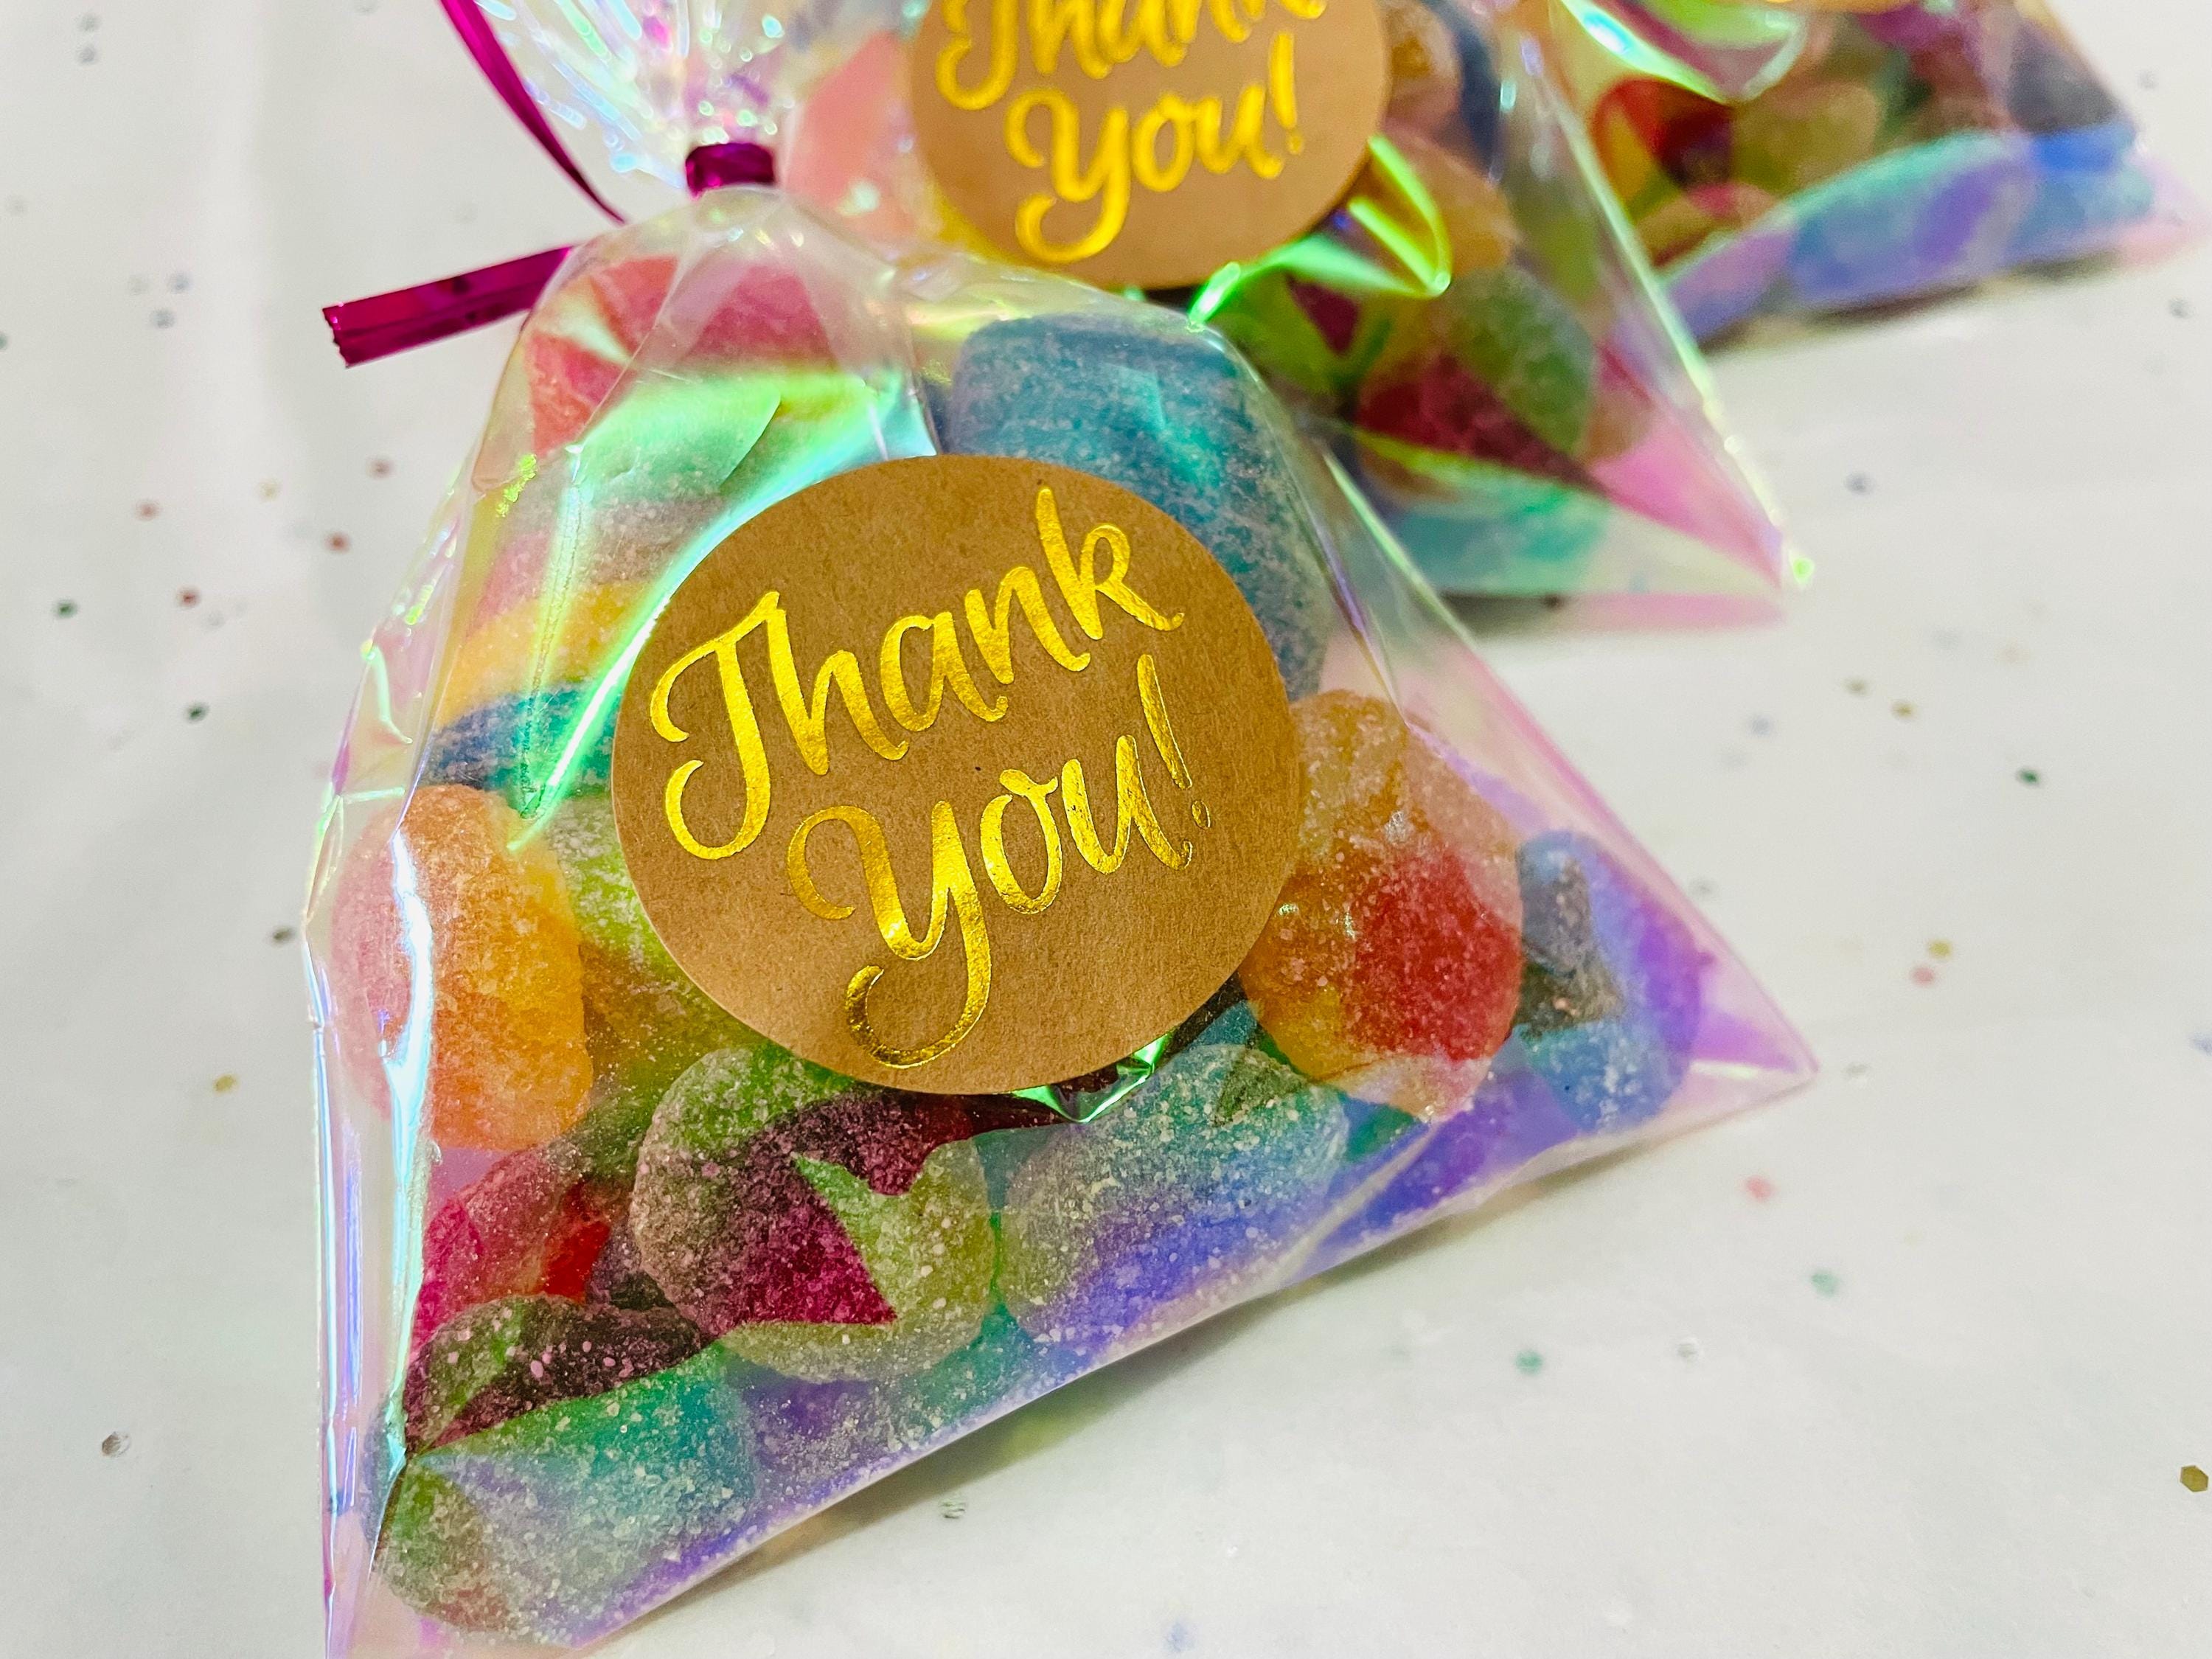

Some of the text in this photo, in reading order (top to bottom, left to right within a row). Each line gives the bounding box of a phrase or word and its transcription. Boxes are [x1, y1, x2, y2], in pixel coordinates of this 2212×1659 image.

[935, 0, 1326, 110] Than
[1004, 32, 1304, 262] You!
[650, 487, 1184, 860] Thank
[786, 654, 1211, 1068] You!
